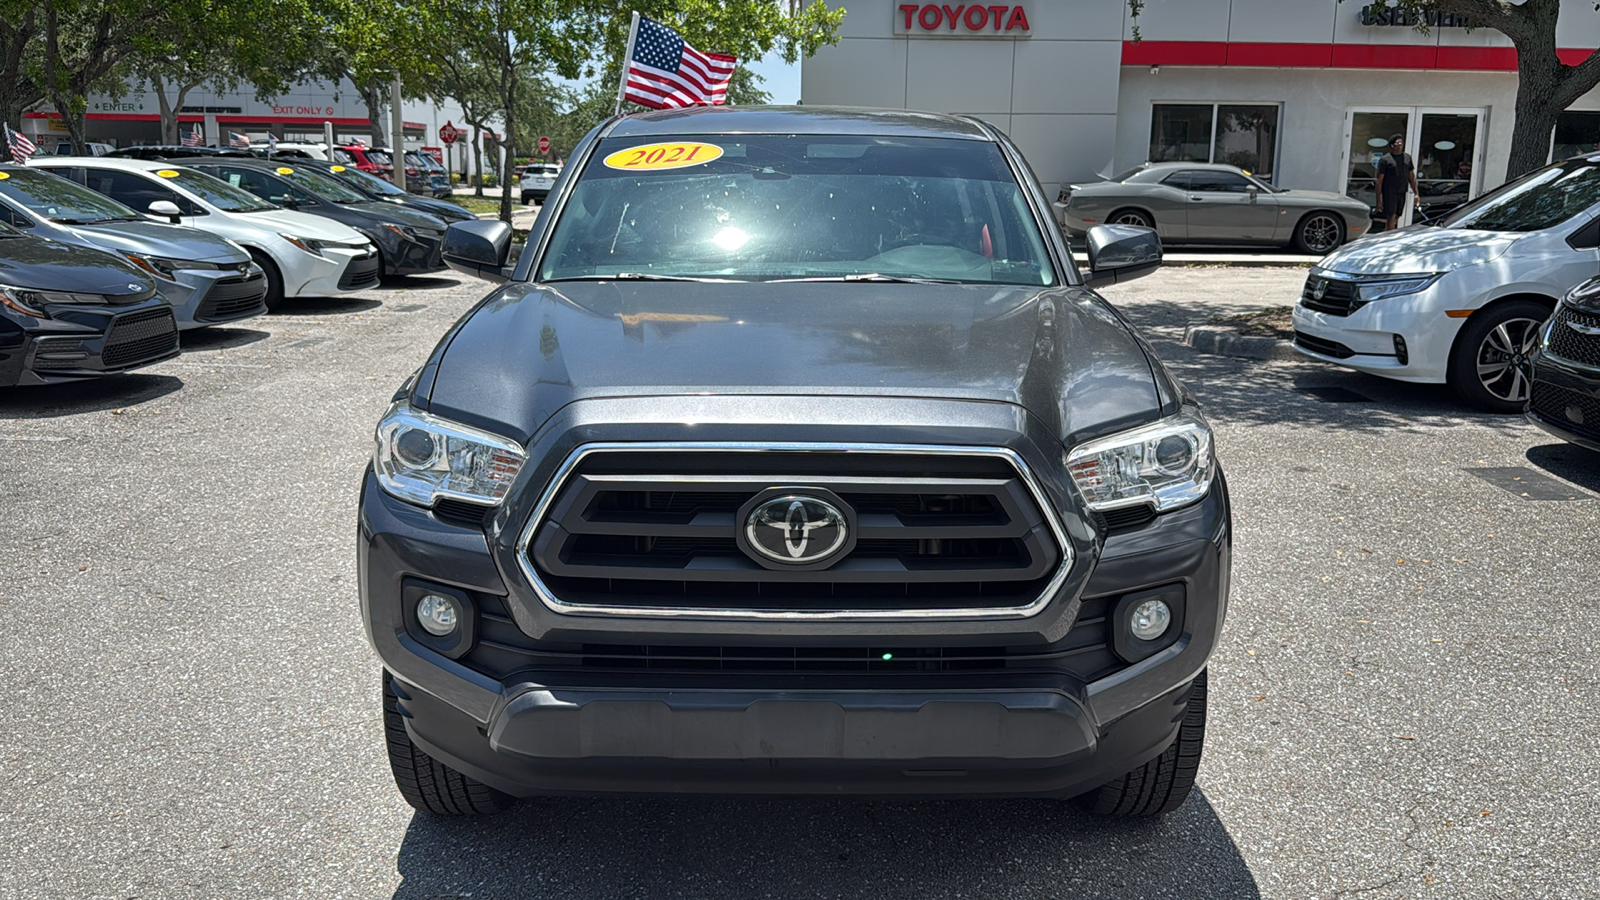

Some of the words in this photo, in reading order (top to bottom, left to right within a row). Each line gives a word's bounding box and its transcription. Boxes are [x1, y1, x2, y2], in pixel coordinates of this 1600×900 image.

[899, 4, 1030, 31] TOYOTA
[1361, 5, 1419, 26] USED
[102, 102, 135, 112] ENTER
[273, 106, 294, 114] EXIT
[296, 106, 322, 115] ONLY
[624, 145, 702, 167] 2021
